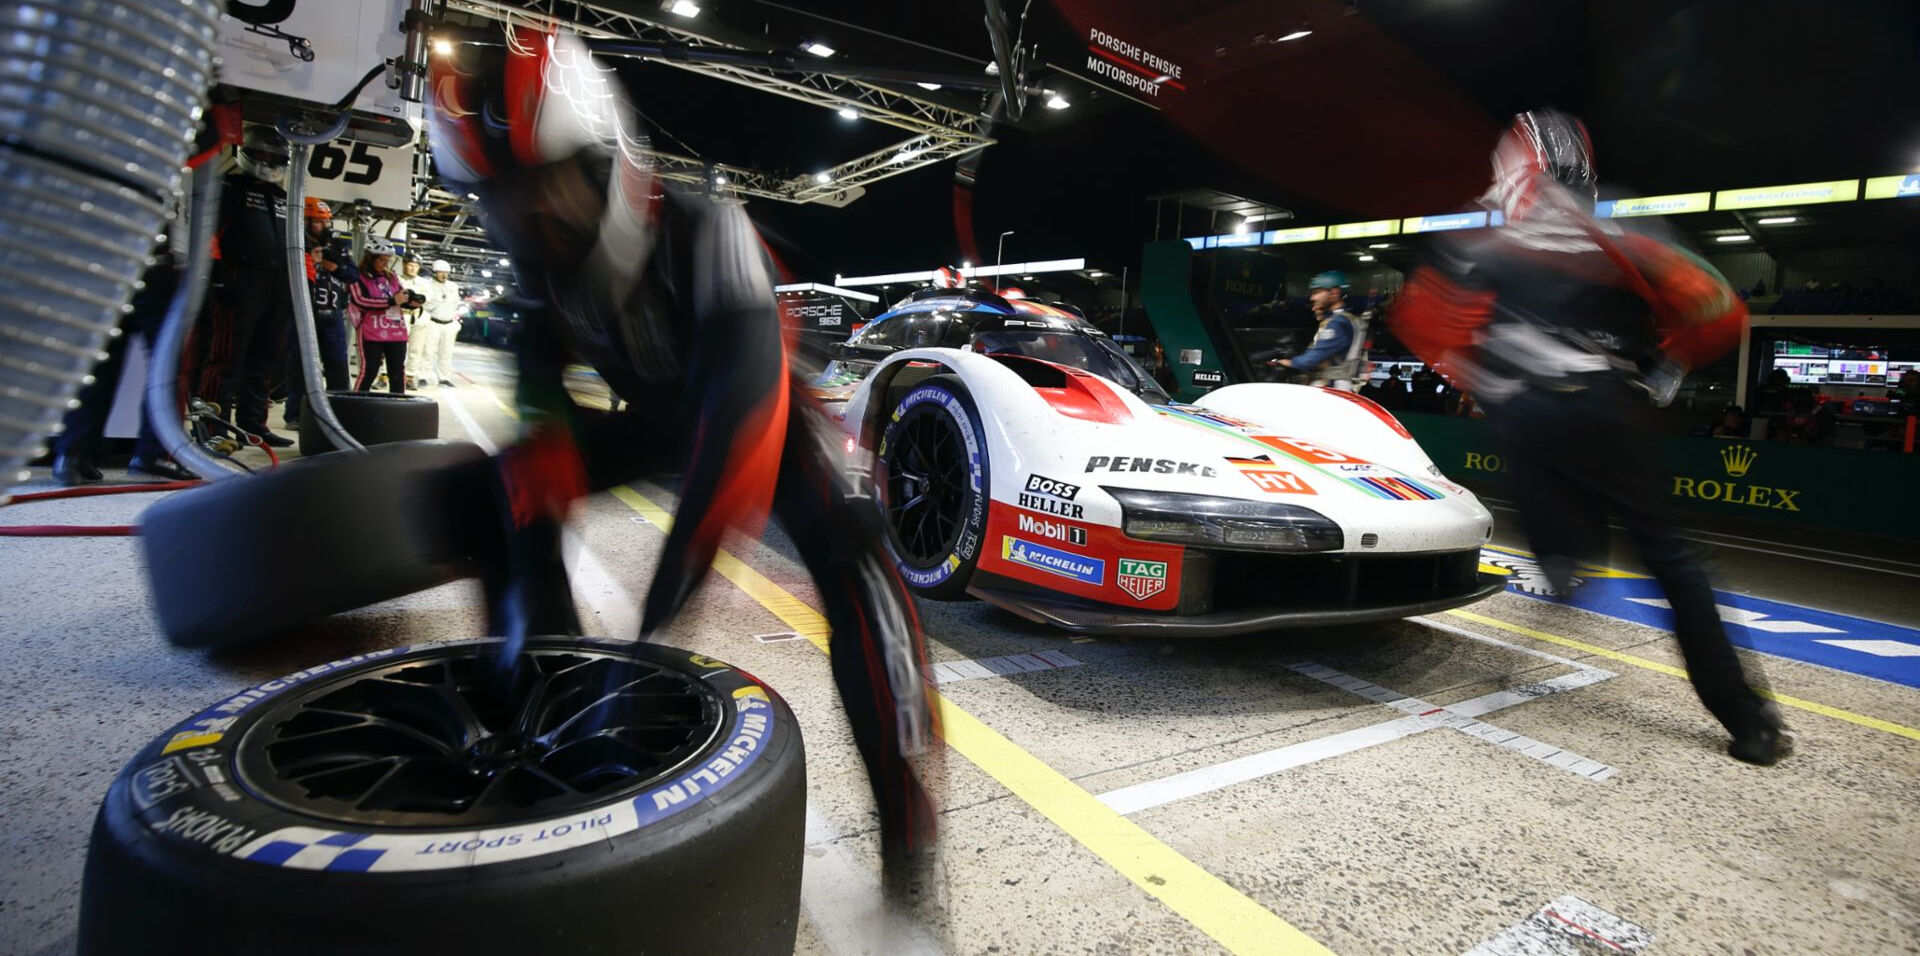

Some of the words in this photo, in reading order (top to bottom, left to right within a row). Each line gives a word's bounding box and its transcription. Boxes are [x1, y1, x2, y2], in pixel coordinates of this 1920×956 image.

[1090, 28, 1141, 61] PORSCHE
[1143, 51, 1182, 79] PENSKE
[1087, 56, 1160, 97] MOTORSPORT
[308, 140, 383, 185] 65
[786, 305, 842, 317] PORSCHE
[1195, 373, 1221, 382] HELLER
[906, 389, 948, 408] MICHELIN
[1277, 437, 1351, 462] 5
[1084, 456, 1217, 478] PENSKE
[1028, 476, 1075, 498] BOSS
[1247, 473, 1303, 490] HY
[1672, 476, 1801, 511] ROLEX
[1018, 492, 1084, 519] HELLER
[1018, 514, 1066, 541] Mobil
[1073, 529, 1080, 543] 1
[1028, 551, 1094, 575] MICHELIN
[1122, 561, 1162, 576] TAG
[1120, 577, 1162, 597] HEUER
[215, 649, 394, 713] MICHELIN
[652, 713, 767, 812] MICHELIN
[533, 814, 612, 842] PILOT
[415, 833, 524, 856] SPORT
